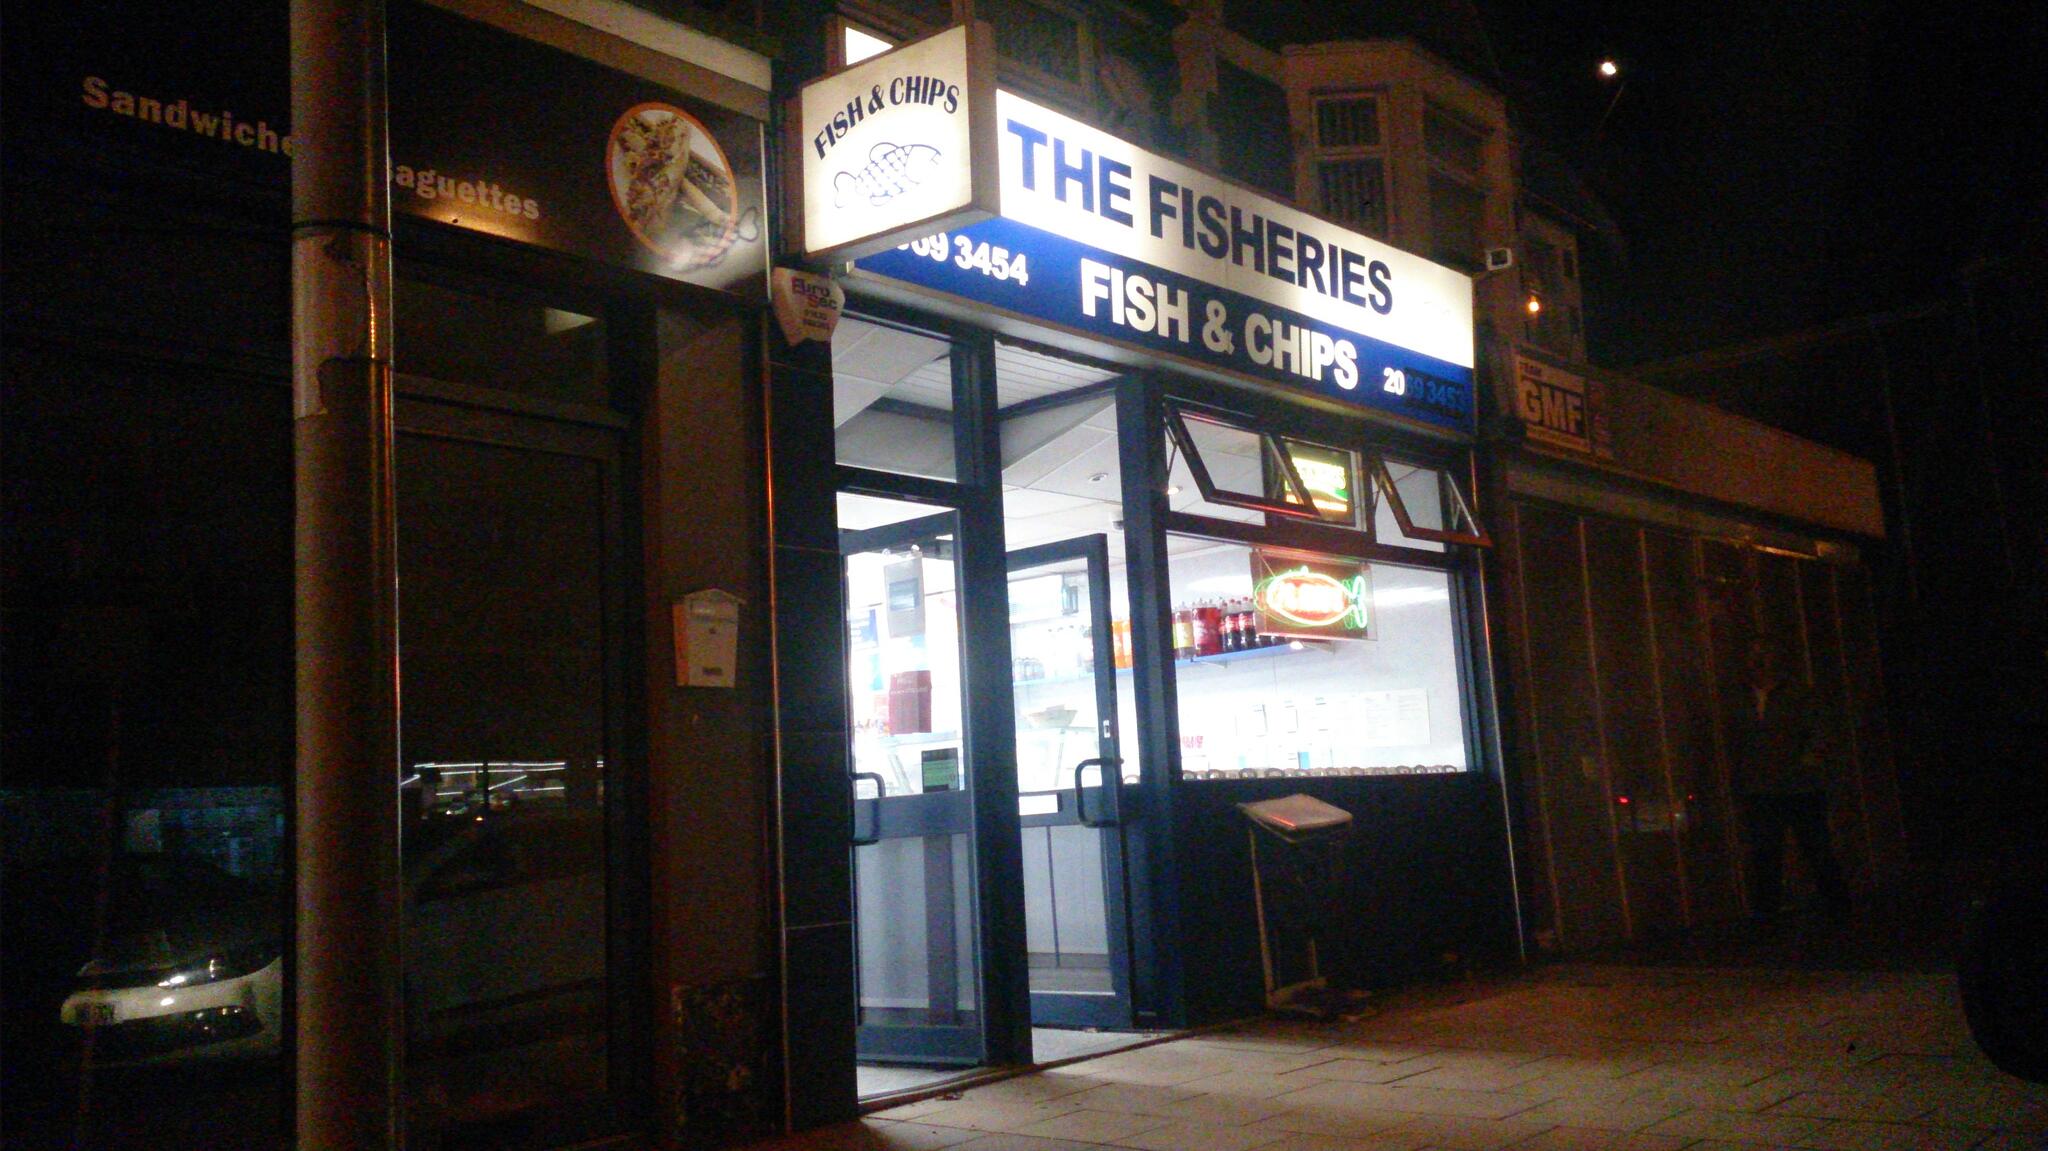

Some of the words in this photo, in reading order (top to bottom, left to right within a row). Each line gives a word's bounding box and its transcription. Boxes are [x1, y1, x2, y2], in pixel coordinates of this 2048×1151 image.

[814, 96, 864, 160] FISH
[868, 84, 885, 115] &
[890, 76, 960, 114] CHIPS
[389, 158, 539, 220] aguettes
[1006, 119, 1133, 228] THE
[1149, 174, 1393, 315] FISHERIES
[791, 277, 830, 298] Euro
[954, 234, 1029, 287] 3454
[1080, 258, 1190, 342] FISH
[1202, 300, 1235, 355] &
[1245, 312, 1359, 390] CHIPS
